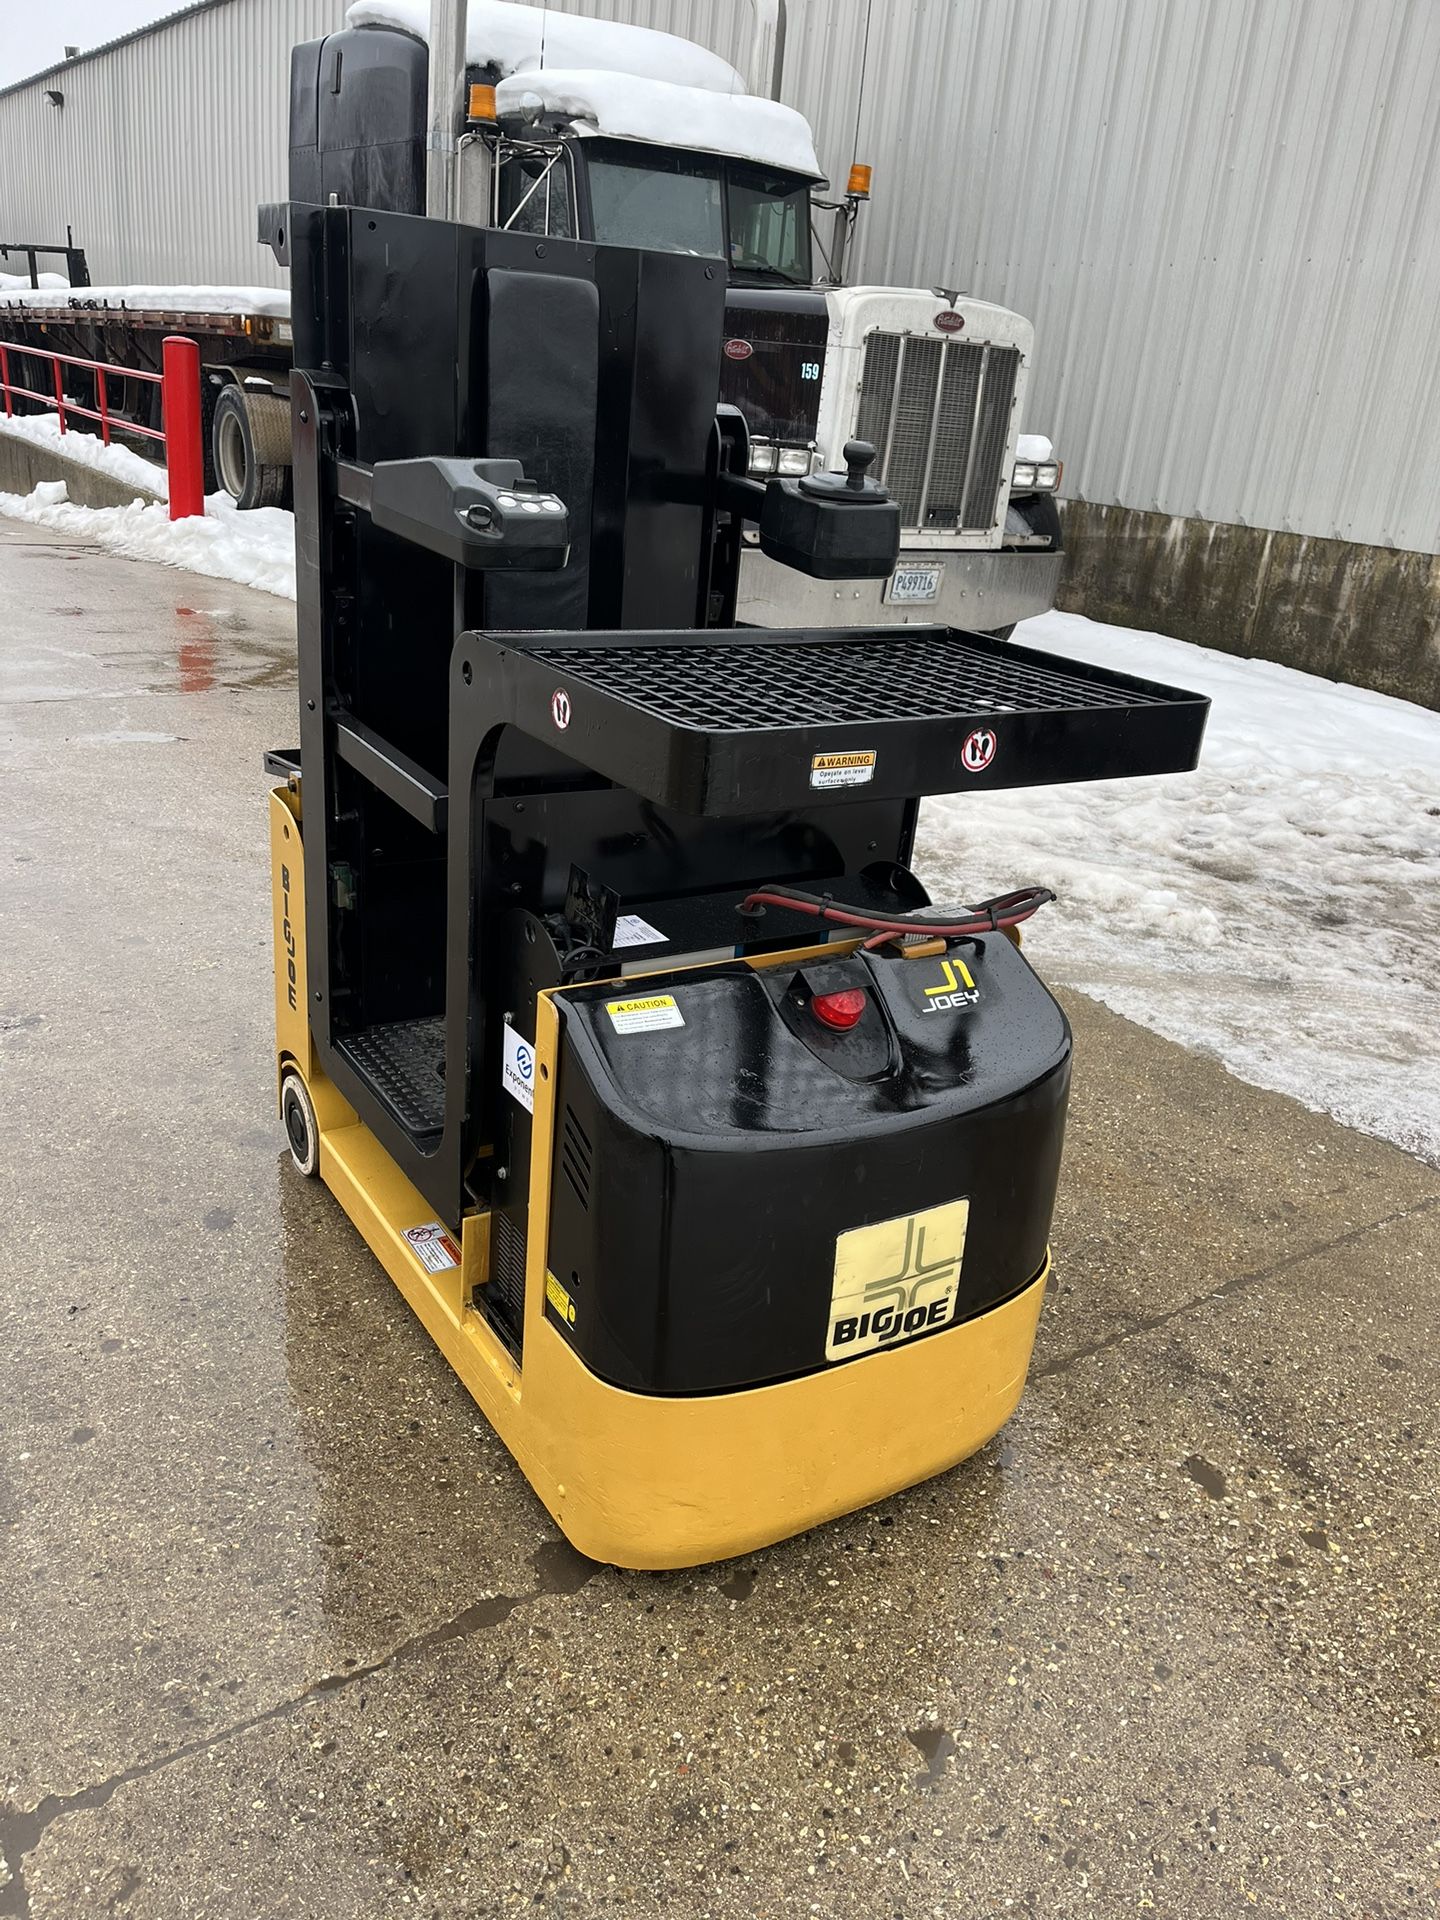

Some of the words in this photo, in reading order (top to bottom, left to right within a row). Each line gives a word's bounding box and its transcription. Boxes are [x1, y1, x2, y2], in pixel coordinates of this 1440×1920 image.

[801, 362, 820, 380] 159
[895, 575, 933, 591] P499716
[827, 755, 870, 767] WARNING
[924, 959, 976, 996] J1
[626, 999, 667, 1011] CAUTION
[922, 989, 980, 1013] JOEY
